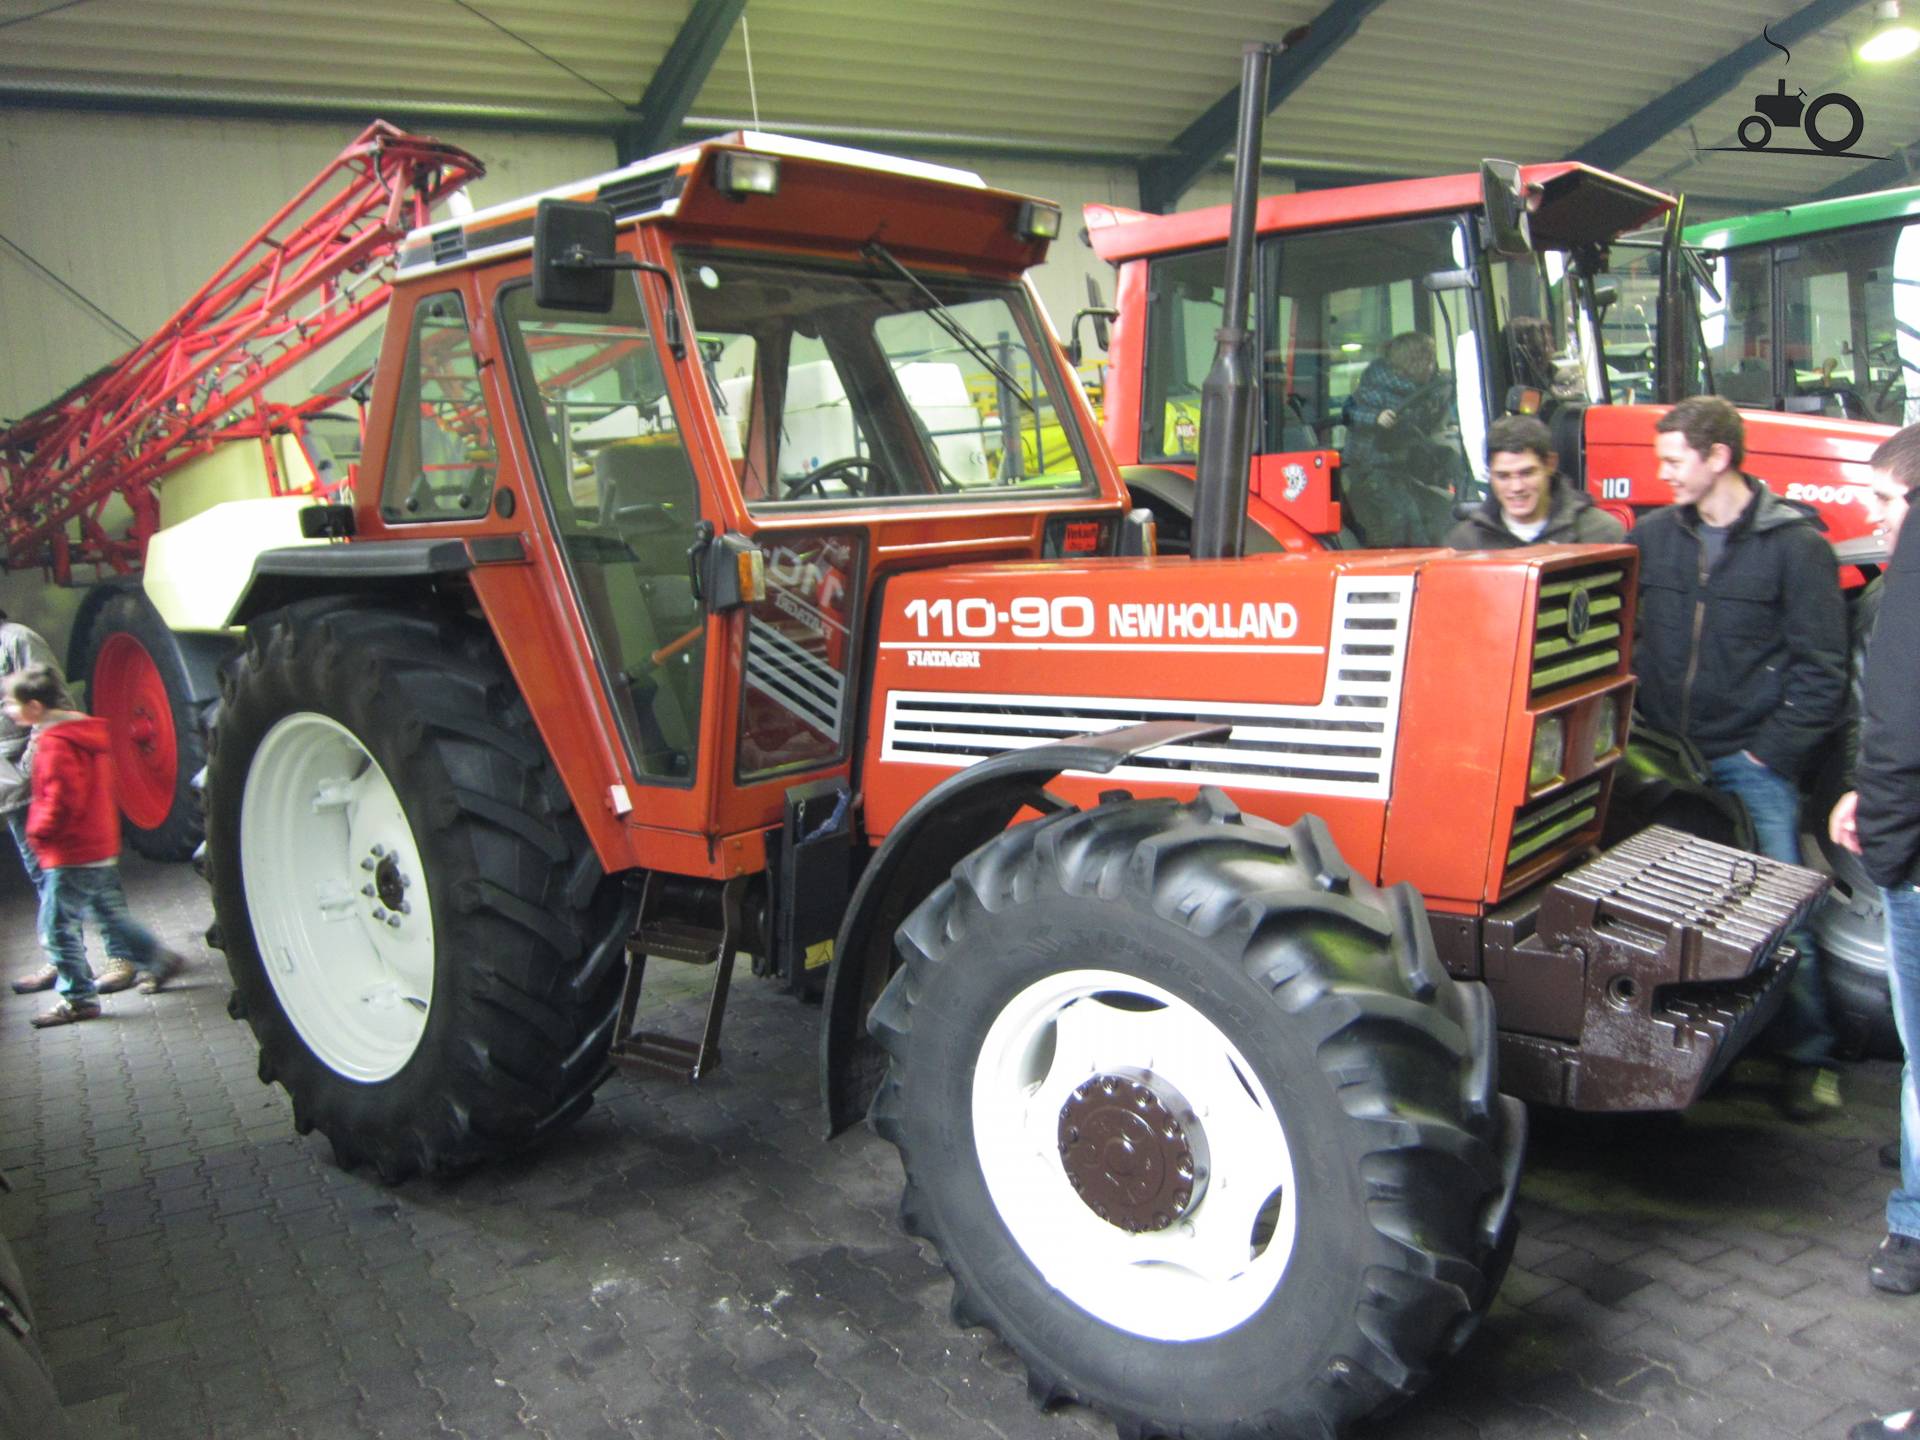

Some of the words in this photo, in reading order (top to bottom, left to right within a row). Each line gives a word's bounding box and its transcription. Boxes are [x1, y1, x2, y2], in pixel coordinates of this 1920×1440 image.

[1602, 478, 1631, 499] 110
[1785, 483, 1853, 505] 2000
[903, 595, 1095, 638] 110-90
[1108, 603, 1166, 638] NEW
[1166, 602, 1299, 639] HOLLAND
[906, 649, 981, 668] FIATAGRI
